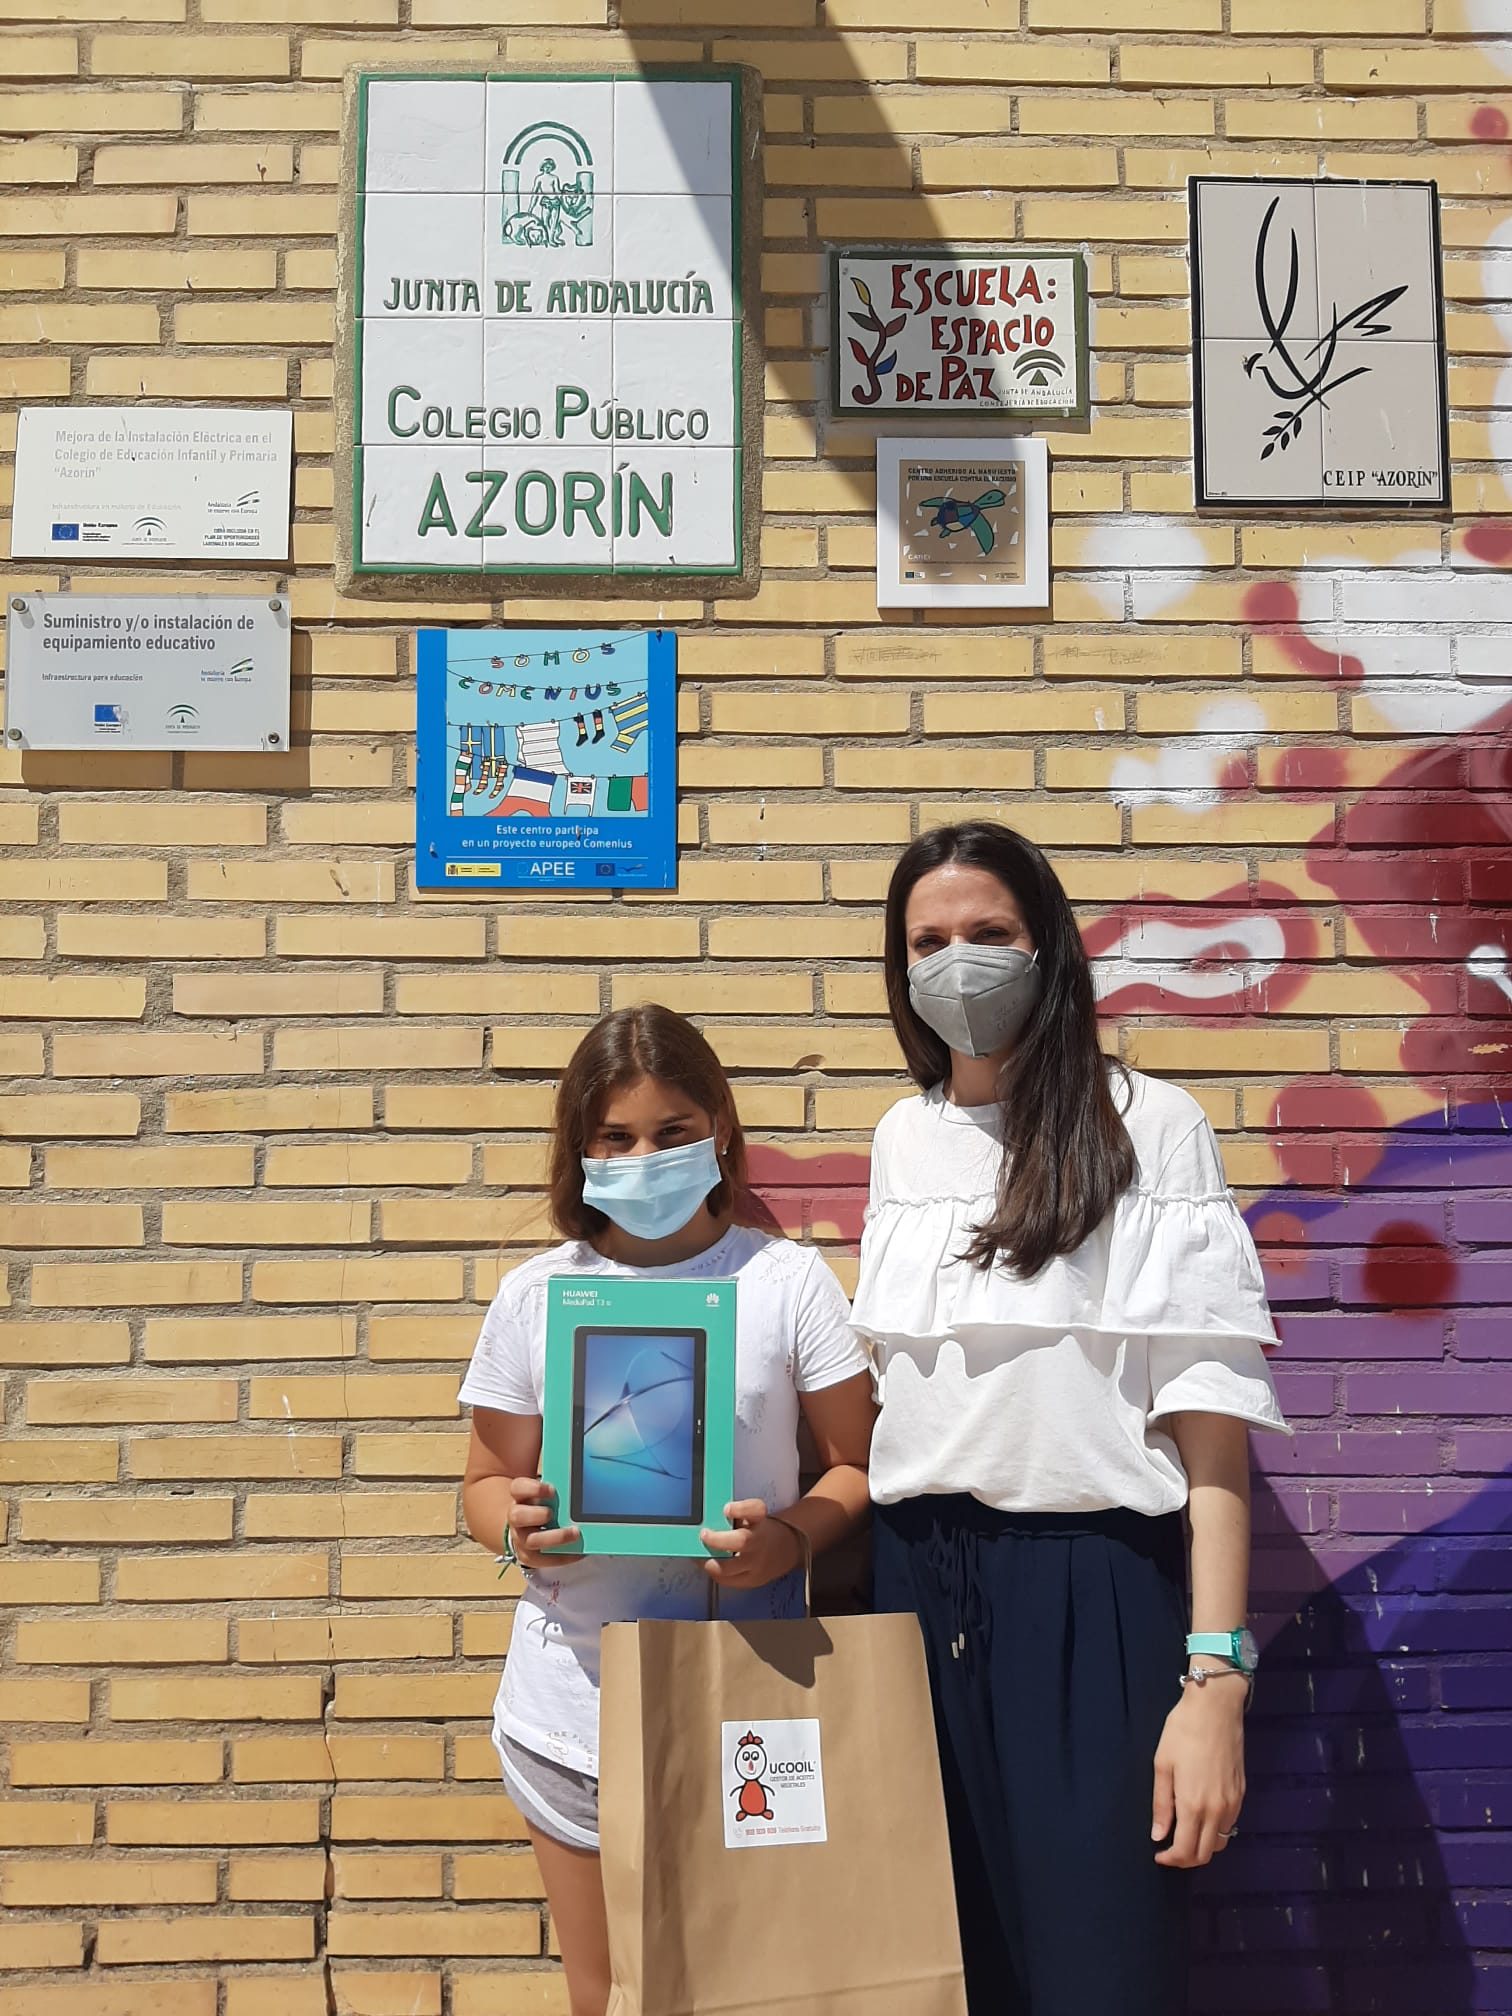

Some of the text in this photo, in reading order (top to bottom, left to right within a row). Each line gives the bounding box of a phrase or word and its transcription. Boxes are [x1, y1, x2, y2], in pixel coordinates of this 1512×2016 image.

[383, 271, 714, 315] JUNTA DE ANDALUCÍA
[891, 263, 1056, 315] ESCUELA:
[930, 314, 1055, 356] ESPACIO
[895, 355, 1001, 402] DE PAZ
[387, 385, 710, 442] COLEGIO PÚBLICO
[55, 430, 272, 445] Mejora de la Instalación Eléctrica en el
[54, 448, 277, 464] Colegio de Educación Infantil y Primaria
[1323, 469, 1366, 487] CEIP
[417, 462, 674, 539] AZORÍN
[43, 613, 255, 632] Suministro y/o instalación de
[43, 634, 216, 652] equipamiento educativo
[490, 642, 616, 668] SOMOS
[41, 673, 92, 681] Infraestructura
[93, 674, 108, 682] para
[458, 677, 622, 701] COMENIUS
[496, 824, 600, 838] Este centro participa
[461, 838, 633, 850] en un proyecto europeo Comenius
[529, 861, 576, 876] APEE
[562, 1290, 598, 1298] HUAWEI
[769, 1760, 815, 1775] UCOOIL
